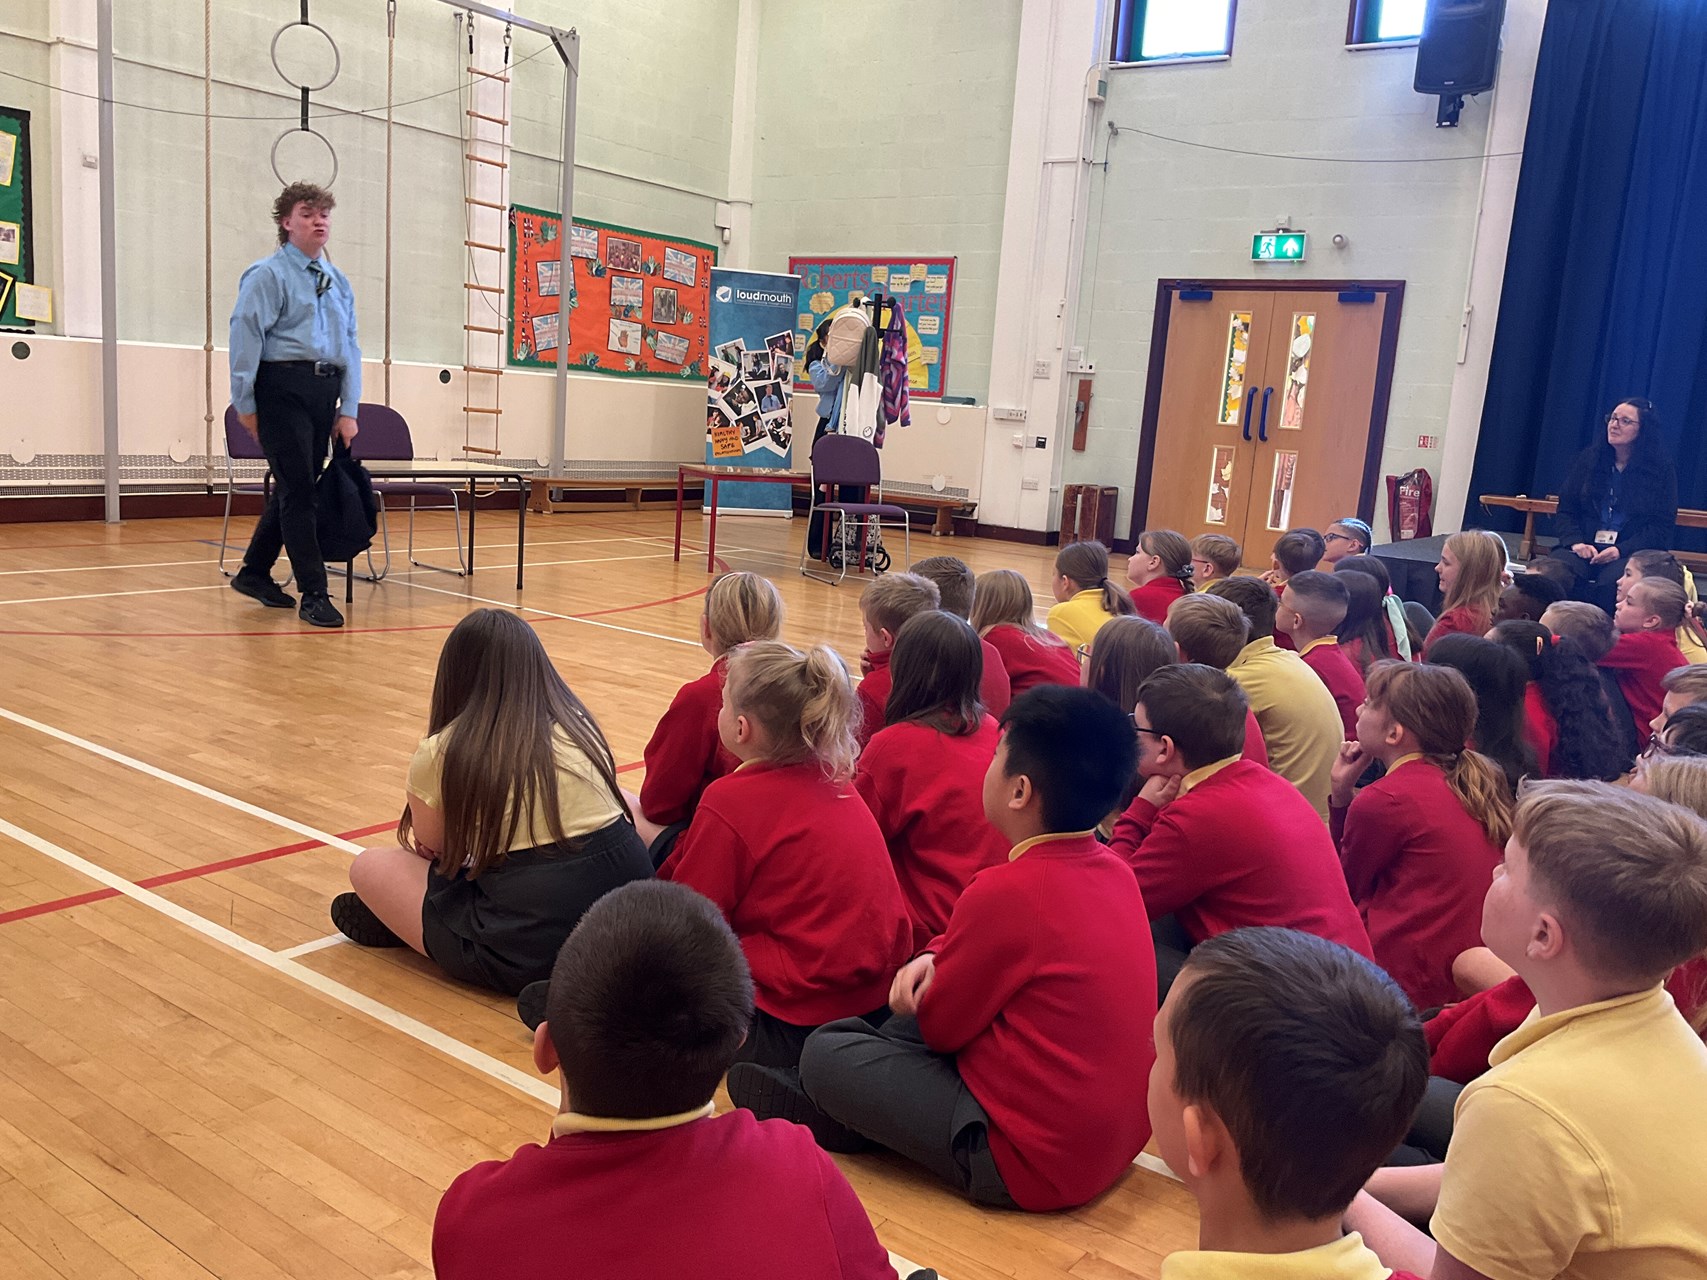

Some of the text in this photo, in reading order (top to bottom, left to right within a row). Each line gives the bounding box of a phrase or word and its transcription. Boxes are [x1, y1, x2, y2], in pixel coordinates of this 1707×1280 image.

[797, 265, 870, 290] Roberts
[736, 289, 792, 304] loudmouth
[1400, 486, 1420, 497] Fire
